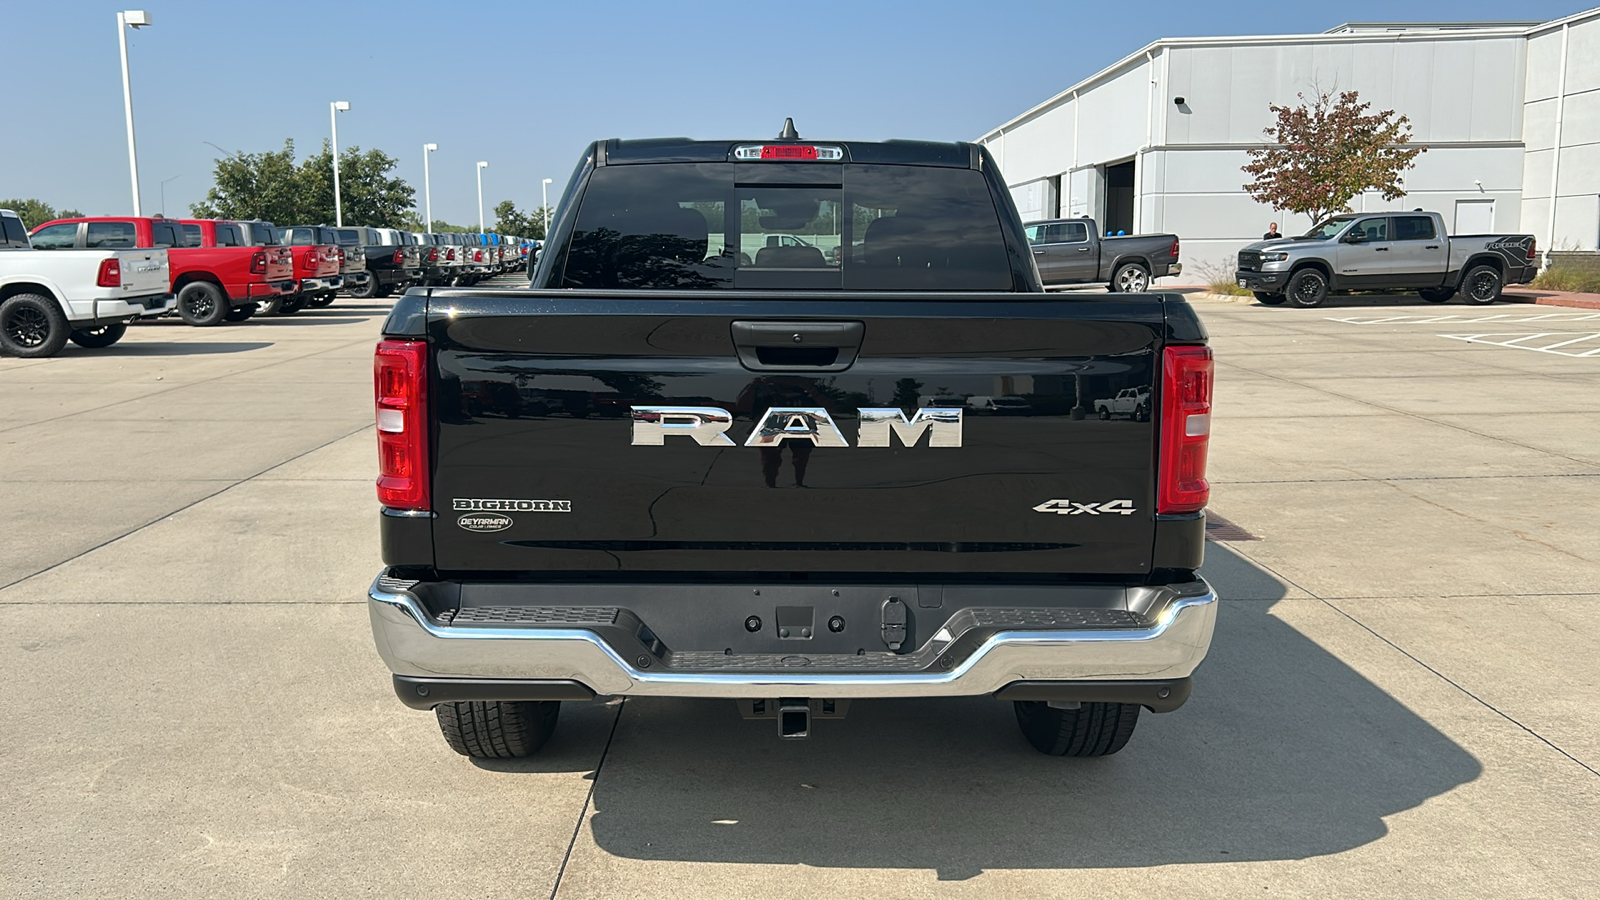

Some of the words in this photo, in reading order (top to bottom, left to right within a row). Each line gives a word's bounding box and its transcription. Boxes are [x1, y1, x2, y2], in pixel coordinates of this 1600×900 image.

[630, 405, 963, 448] RAM
[452, 498, 571, 512] BIGHORN
[1032, 499, 1137, 515] 4x4
